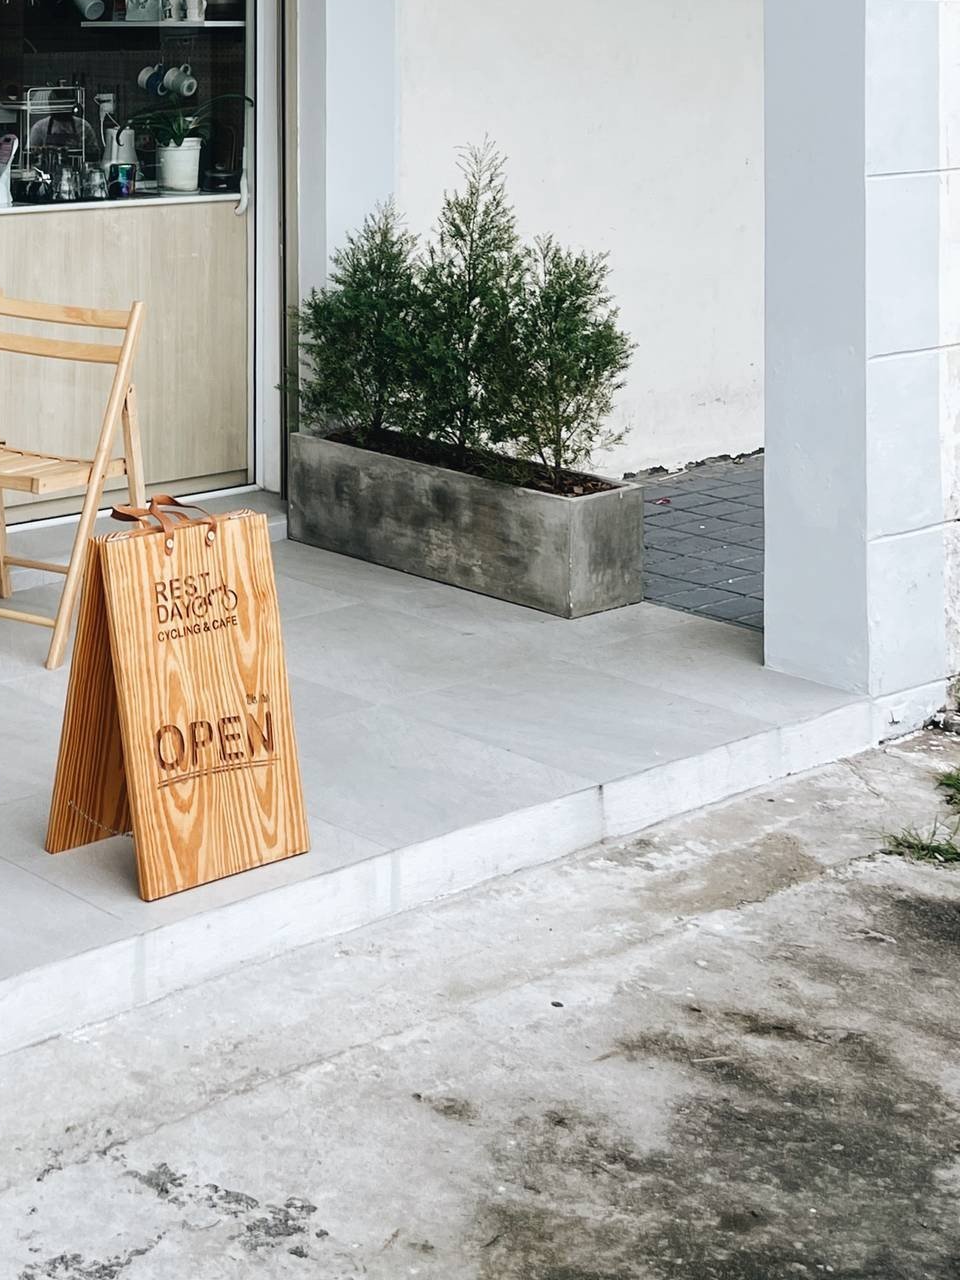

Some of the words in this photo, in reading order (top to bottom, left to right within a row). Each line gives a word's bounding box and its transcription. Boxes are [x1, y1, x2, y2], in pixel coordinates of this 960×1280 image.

[154, 571, 210, 604] REST
[156, 599, 192, 625] DAY
[157, 623, 201, 642] CYCLING
[203, 621, 211, 633] &
[211, 615, 238, 630] CAFE
[153, 710, 274, 771] OPEN
